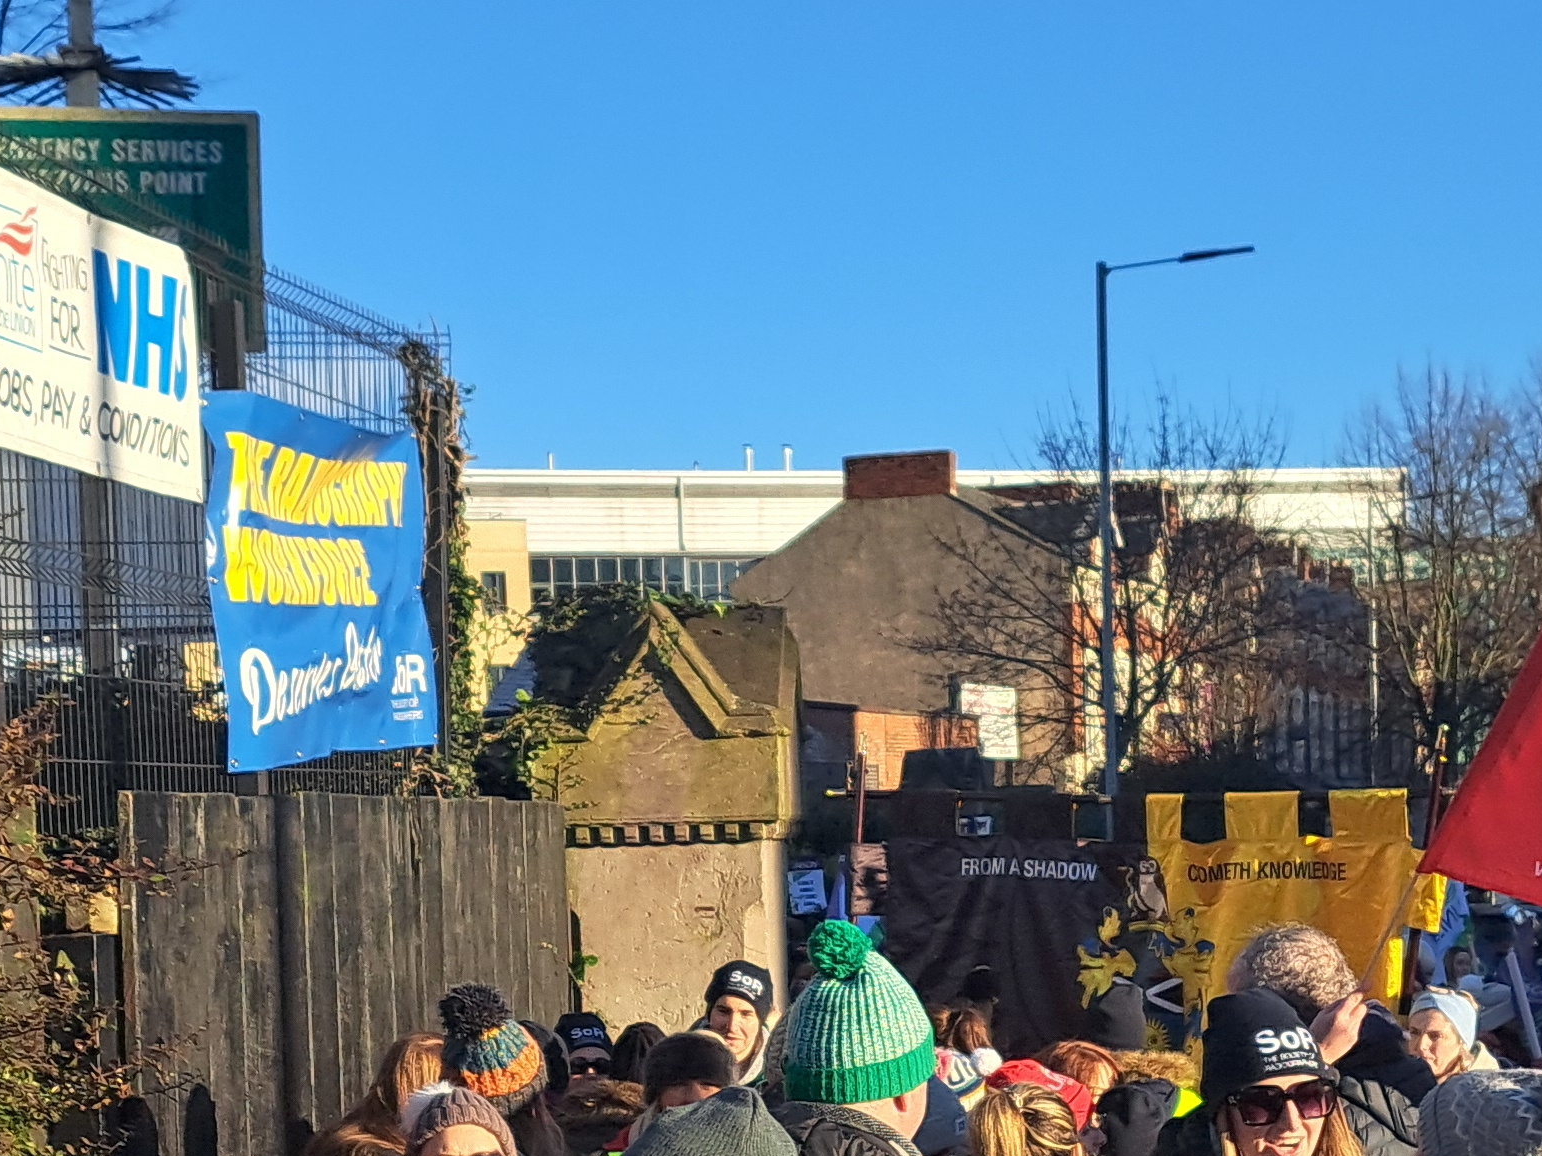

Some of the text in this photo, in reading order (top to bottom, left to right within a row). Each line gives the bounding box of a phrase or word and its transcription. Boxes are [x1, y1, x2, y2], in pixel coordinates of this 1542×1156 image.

[111, 138, 223, 164] SERVICES
[139, 170, 207, 195] POINT
[42, 236, 89, 292] FIGHTING
[51, 248, 188, 402] FOR NHS
[40, 380, 77, 430] PAY
[79, 395, 92, 436] &
[97, 401, 191, 467] CONDITIONS
[223, 525, 379, 606] WORKFORCE
[240, 647, 341, 735] Deserves
[960, 857, 1099, 881] FROM A SHADOW
[1187, 860, 1347, 883] COMETH KNOWLEDGE
[729, 970, 763, 996] SoR
[570, 1027, 605, 1040] SoR
[1255, 1026, 1318, 1054] SoR
